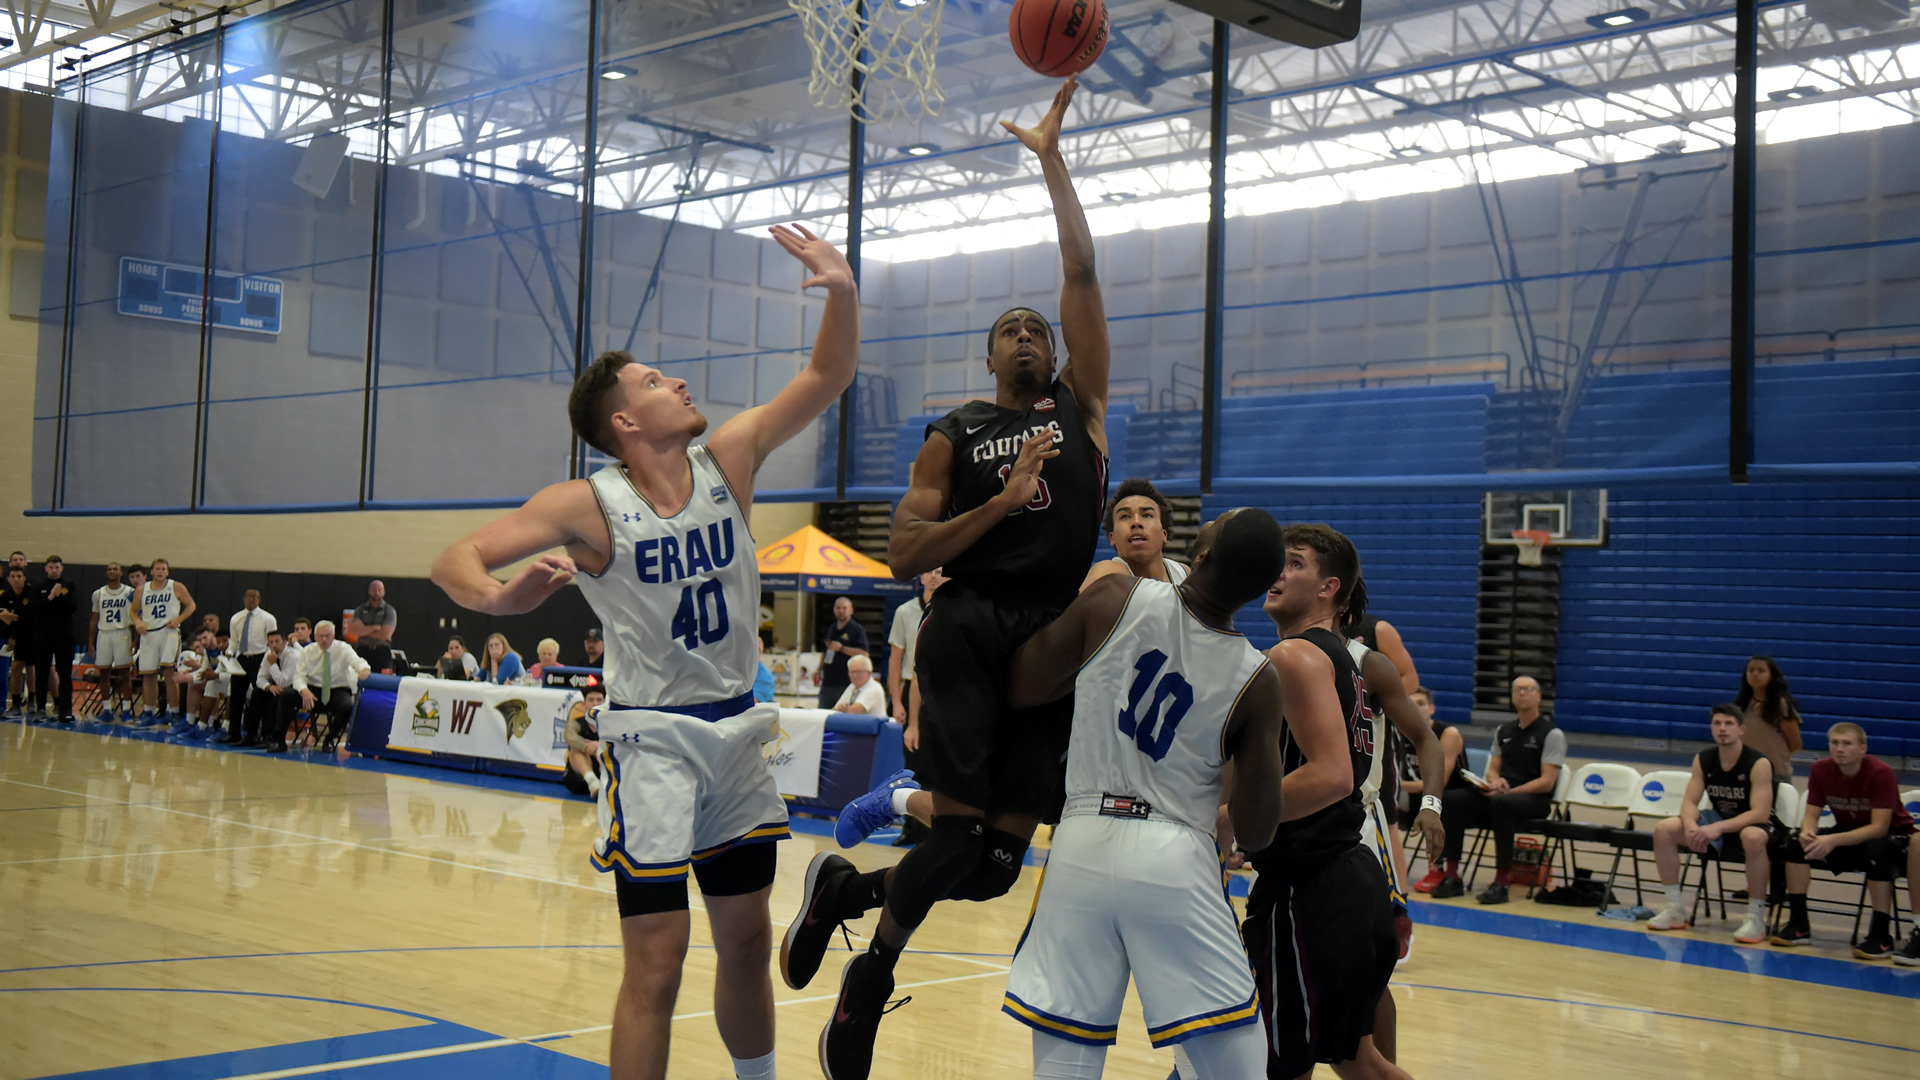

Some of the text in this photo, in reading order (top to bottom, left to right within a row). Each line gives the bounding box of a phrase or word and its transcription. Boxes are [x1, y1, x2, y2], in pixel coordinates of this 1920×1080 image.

[128, 262, 159, 277] HOME
[244, 279, 281, 295] VISITOR
[138, 304, 163, 315] BONUS
[240, 317, 263, 328] BONUS
[635, 517, 735, 584] ERAU
[101, 598, 127, 609] ERAU
[145, 593, 172, 605] ERAU
[106, 609, 121, 623] 24
[151, 605, 166, 619] 42
[671, 577, 729, 652] 40
[1118, 648, 1194, 762] 10
[450, 699, 483, 735] WT
[1706, 785, 1745, 799] COUGRS
